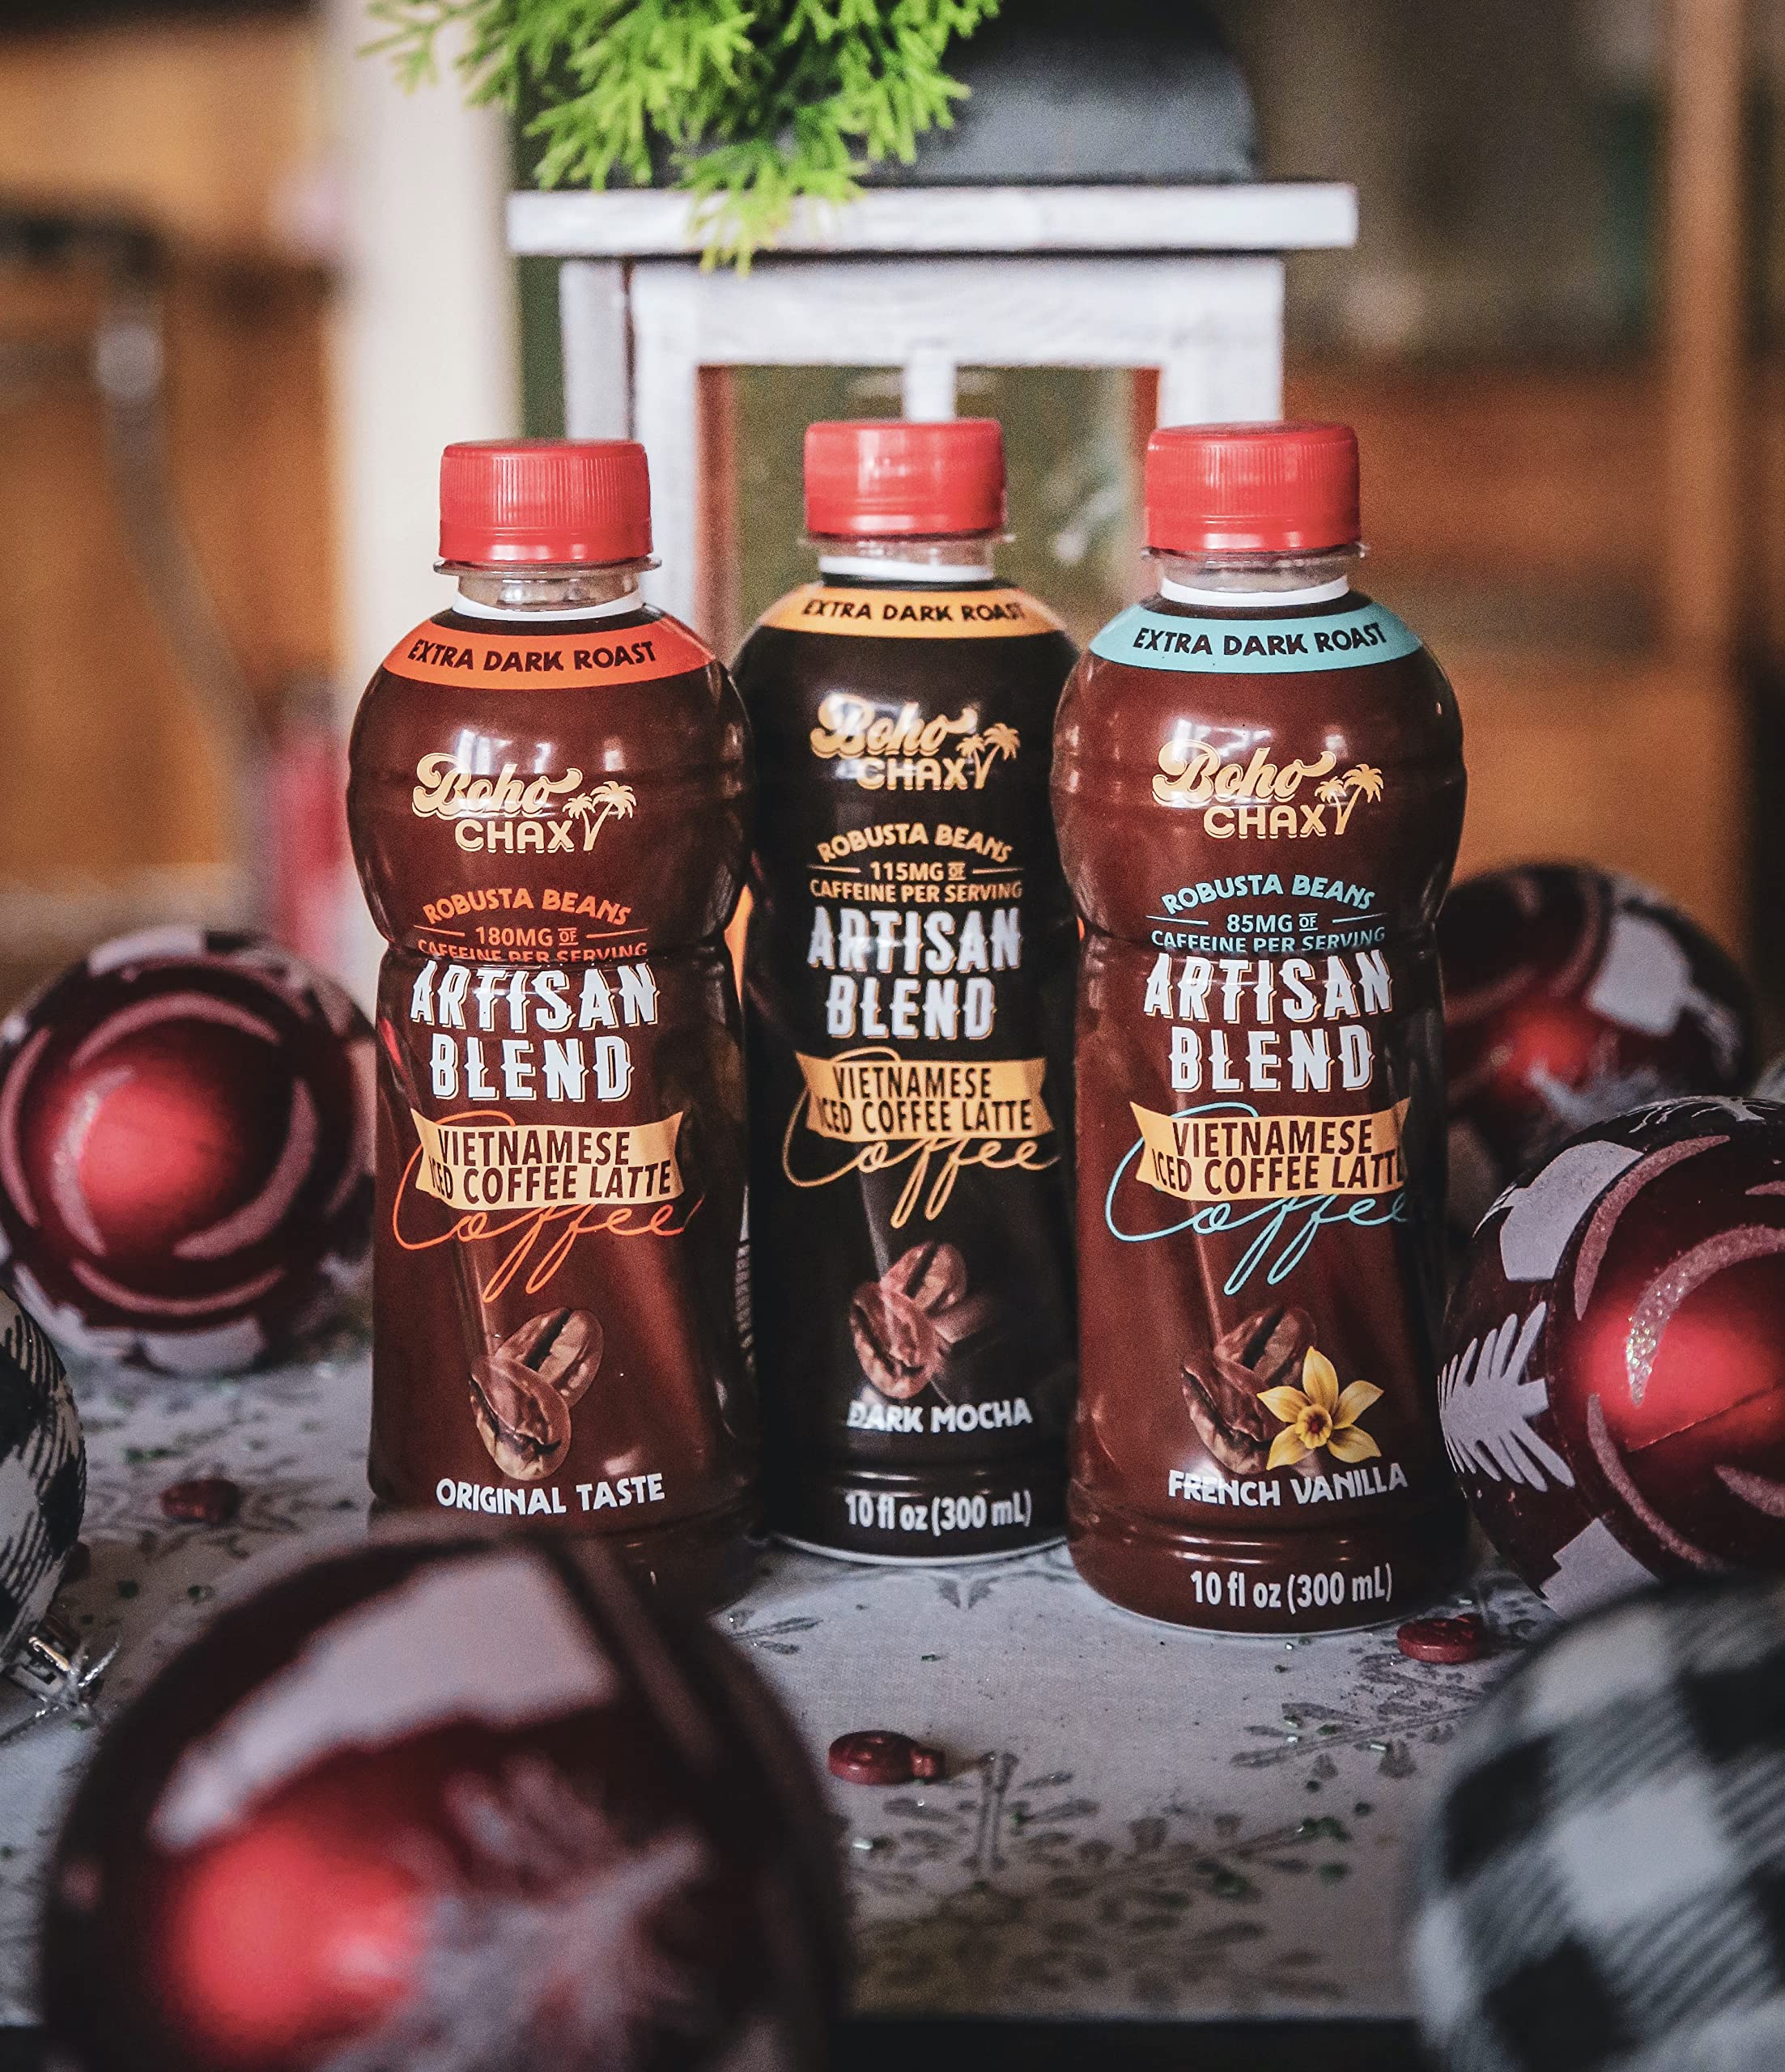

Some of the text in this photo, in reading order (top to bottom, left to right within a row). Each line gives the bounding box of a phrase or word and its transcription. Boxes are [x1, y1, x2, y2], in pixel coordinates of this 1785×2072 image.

[802, 598, 872, 620] EXTRA
[883, 603, 952, 622] DARK
[407, 639, 658, 673] EXTRA DARK ROAST
[1133, 622, 1388, 656] EXTRA DARK ROAST
[810, 694, 978, 759] Boho
[411, 752, 584, 821] Boho
[856, 757, 968, 791] CHAX
[1152, 739, 1337, 807] Boho
[455, 820, 576, 855] CHAX
[1203, 804, 1328, 839] CHAX
[816, 822, 1014, 864] ROBUSTA BEANS
[810, 879, 1023, 903] CAFFEINE PER SERVING
[870, 861, 944, 881] 115MG
[423, 888, 631, 927] ROBUSTA BEANS
[1161, 873, 1376, 915] ROBUSTA BEANS
[475, 927, 579, 947] 180MG OF
[807, 905, 1022, 974] ARTISAN
[1151, 926, 1386, 953] CAFFEINE PER SERVING
[1226, 912, 1319, 933] 85MG OF
[417, 939, 501, 962] CAFFEINE
[556, 942, 648, 963] SERVING
[410, 960, 661, 1033] ARTISAN
[825, 974, 997, 1040] BLEND
[1143, 949, 1393, 1025] ARTISAN
[430, 1034, 635, 1102] BLEND
[1168, 1025, 1375, 1093] BLEND
[833, 1066, 991, 1099] VIETNAMESE
[862, 1100, 950, 1135] COFFEE
[961, 1099, 1033, 1132] LATTE
[438, 1128, 631, 1167] VIETNAMESE
[1172, 1118, 1372, 1159] VIETNAMESE
[428, 1155, 671, 1204] ICED COFFEE LATTE
[1151, 1148, 1192, 1192] ICED
[1204, 1155, 1319, 1195] COFFEE
[846, 1398, 1033, 1433] DARK MOCHA
[436, 1472, 665, 1515] ORIGINAL TASTE
[1168, 1463, 1408, 1507] FRENCH VANILLA
[845, 1489, 1032, 1537] 10 fl oz (300 mL)
[1190, 1563, 1392, 1614] 10 fl oz (300 mL)
